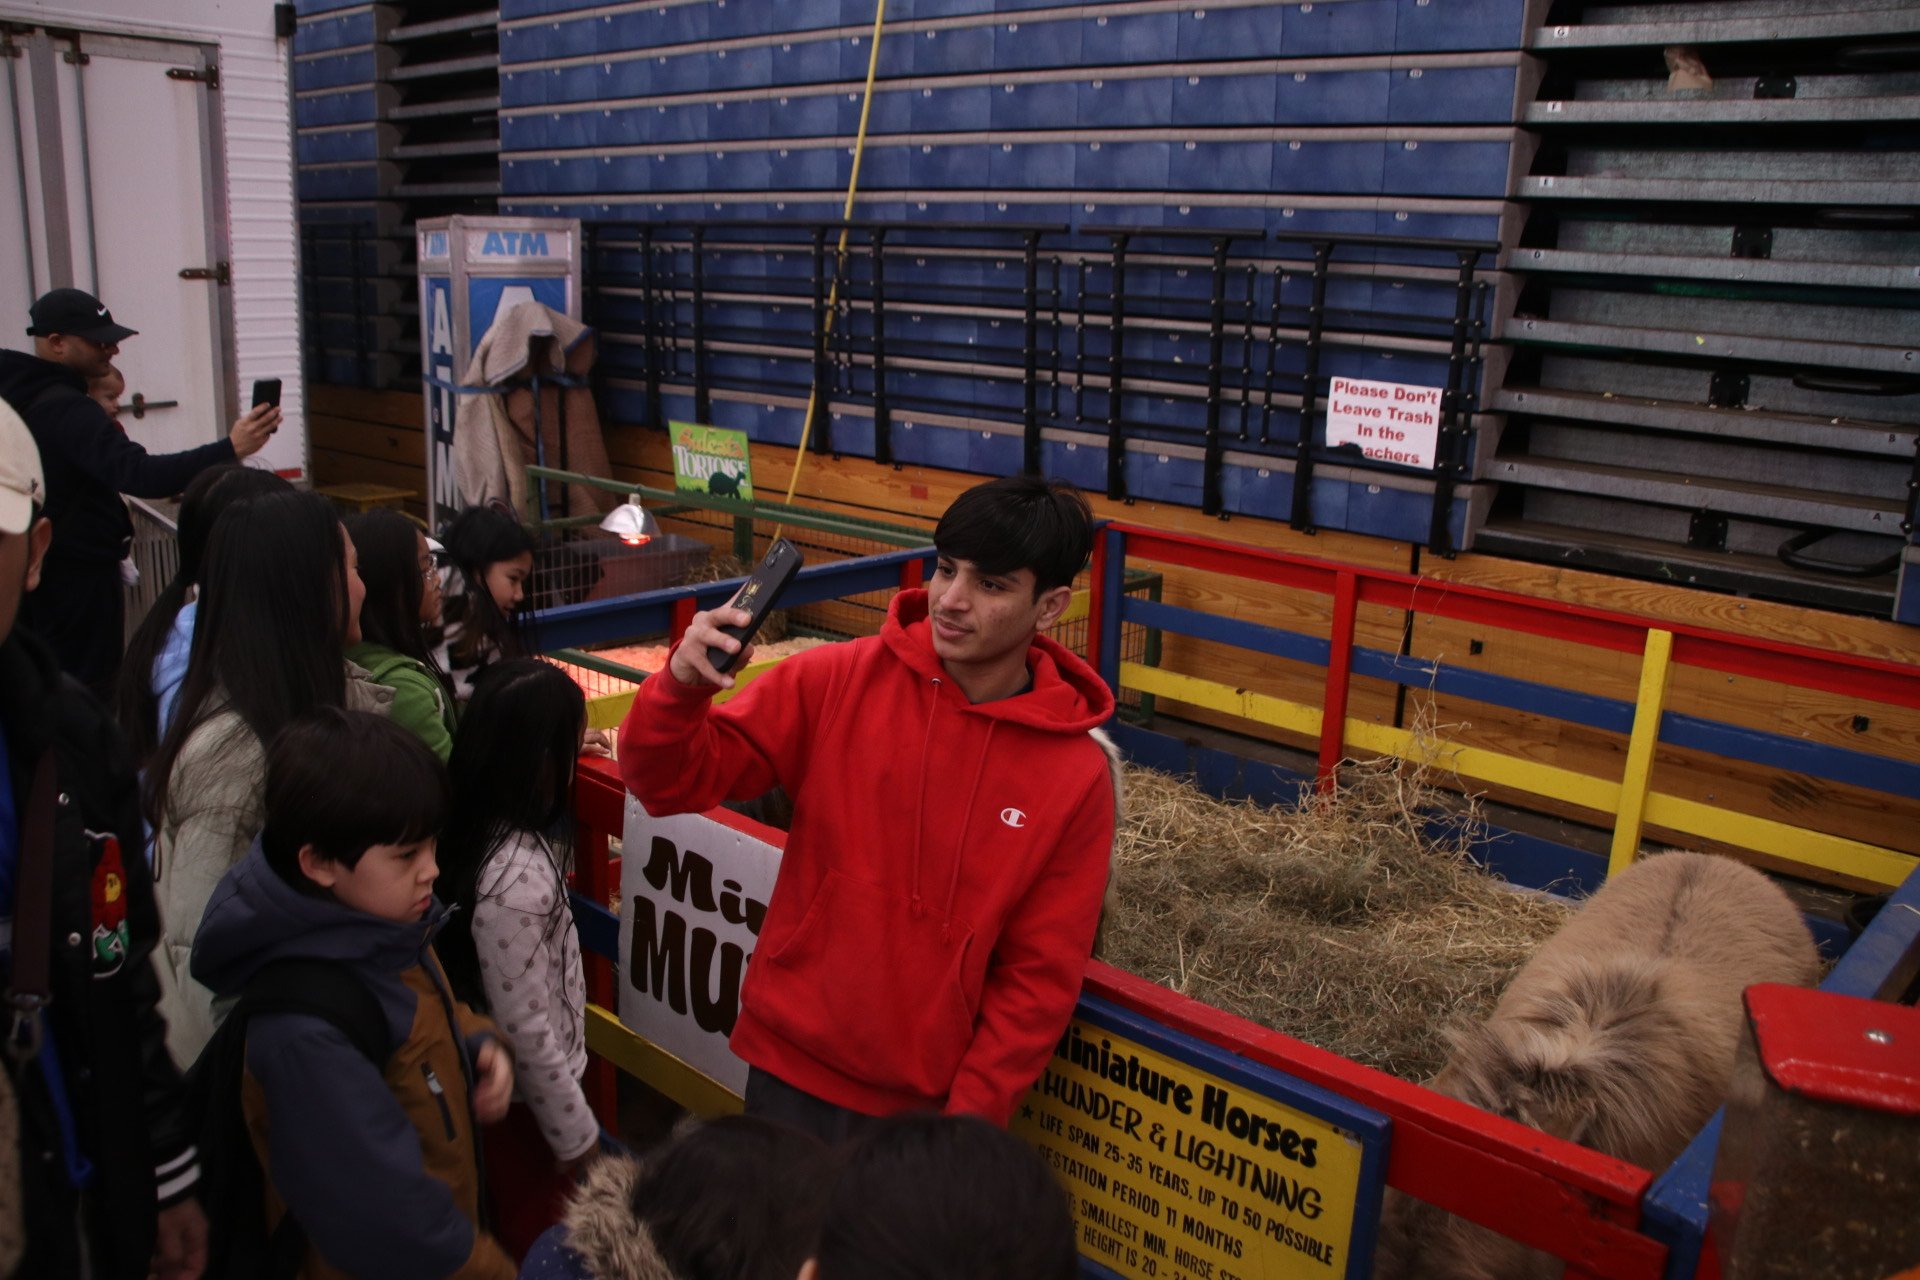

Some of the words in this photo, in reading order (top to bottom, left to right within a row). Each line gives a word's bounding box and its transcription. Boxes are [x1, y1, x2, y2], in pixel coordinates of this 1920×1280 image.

[481, 231, 549, 257] ATM
[1904, 352, 1913, 361] C
[1334, 380, 1389, 399] Please
[1394, 387, 1438, 405] Don't
[1332, 401, 1382, 418] Leave
[1388, 406, 1433, 425] Trash
[1357, 423, 1373, 438] In
[1378, 427, 1405, 442] the
[672, 444, 748, 487] TORTOISE
[1339, 440, 1421, 465] achers
[1873, 512, 1881, 521] A
[1200, 1083, 1318, 1168] Horses
[1149, 1122, 1167, 1152] &
[1174, 1128, 1324, 1220] LIGHTNING
[1039, 1110, 1063, 1133] LIFE
[1068, 1126, 1100, 1155] SPAN
[1104, 1142, 1143, 1174] 25-35
[1149, 1162, 1193, 1200] YEARS,
[1199, 1185, 1216, 1208] UP
[1221, 1195, 1239, 1221] TO
[1243, 1207, 1261, 1231] 50
[1265, 1221, 1334, 1267] POSSIBLE
[1112, 1180, 1160, 1217] PERIOD
[1166, 1205, 1177, 1227] 11
[1182, 1214, 1243, 1259] MONTHS
[1081, 1198, 1138, 1244] SMALLEST
[1143, 1228, 1169, 1259] MIN.
[1174, 1244, 1215, 1280] HORSE
[1084, 1223, 1124, 1261] HEIGHT
[1125, 1245, 1137, 1269] IS
[1141, 1253, 1157, 1278] 20
